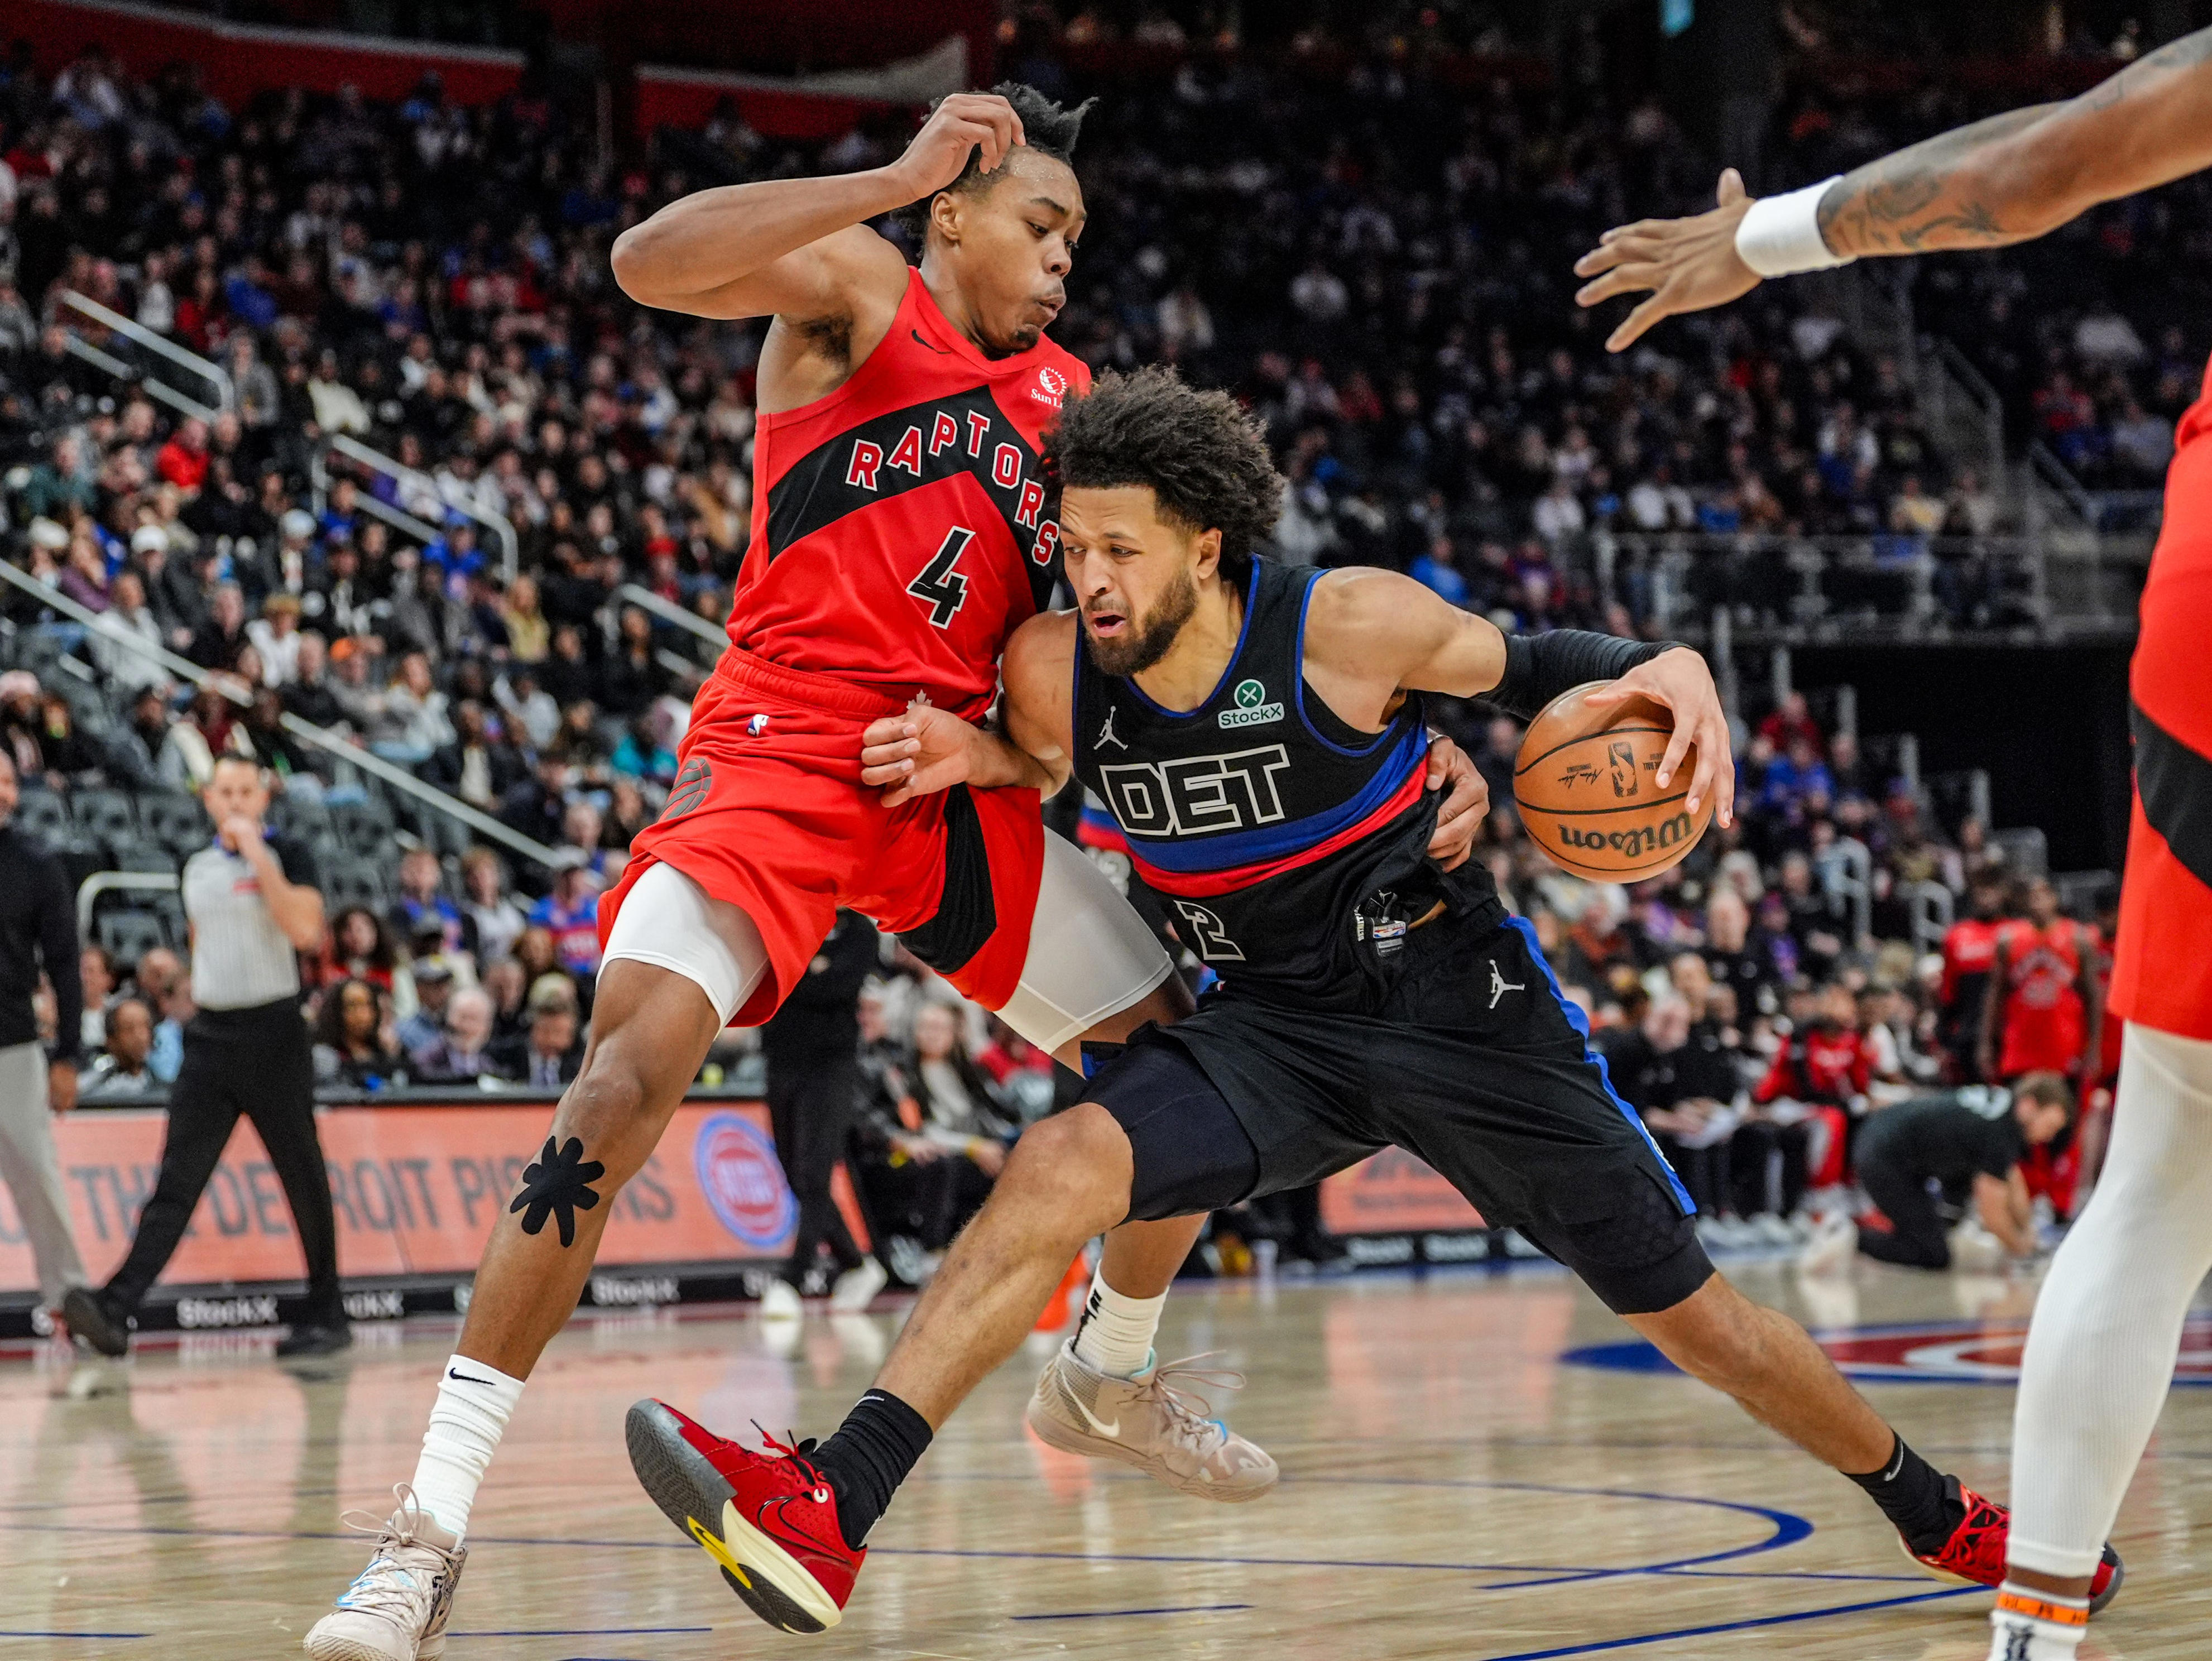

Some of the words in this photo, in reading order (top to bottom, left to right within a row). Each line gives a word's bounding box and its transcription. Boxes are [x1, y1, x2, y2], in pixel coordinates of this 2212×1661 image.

[1030, 388, 1052, 405] Sun
[845, 409, 1060, 567] RAPTORS
[905, 525, 976, 630] 4
[1221, 704, 1282, 726] StockX
[1099, 743, 1291, 836] DET
[1558, 811, 1693, 858] Wilson
[1173, 900, 1246, 961] 2
[204, 1156, 441, 1236] DEROIT
